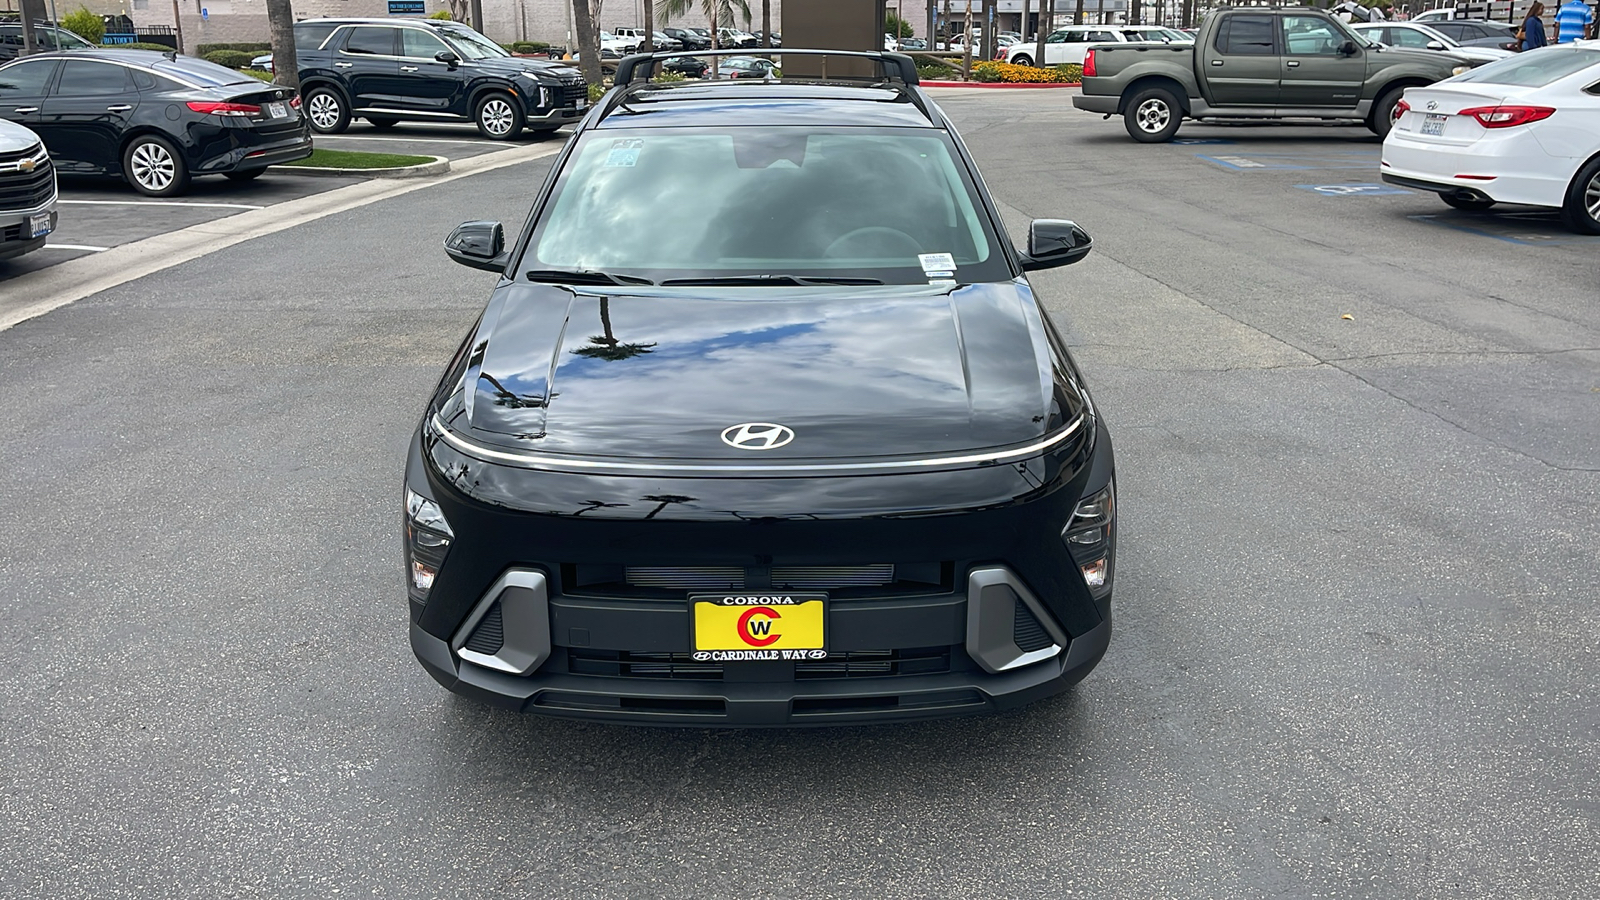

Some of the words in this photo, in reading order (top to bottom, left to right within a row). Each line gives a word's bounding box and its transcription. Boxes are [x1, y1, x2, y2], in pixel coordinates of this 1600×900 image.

[723, 596, 795, 605] CORONA
[712, 650, 780, 661] CARDINALE
[782, 649, 808, 660] WAY
